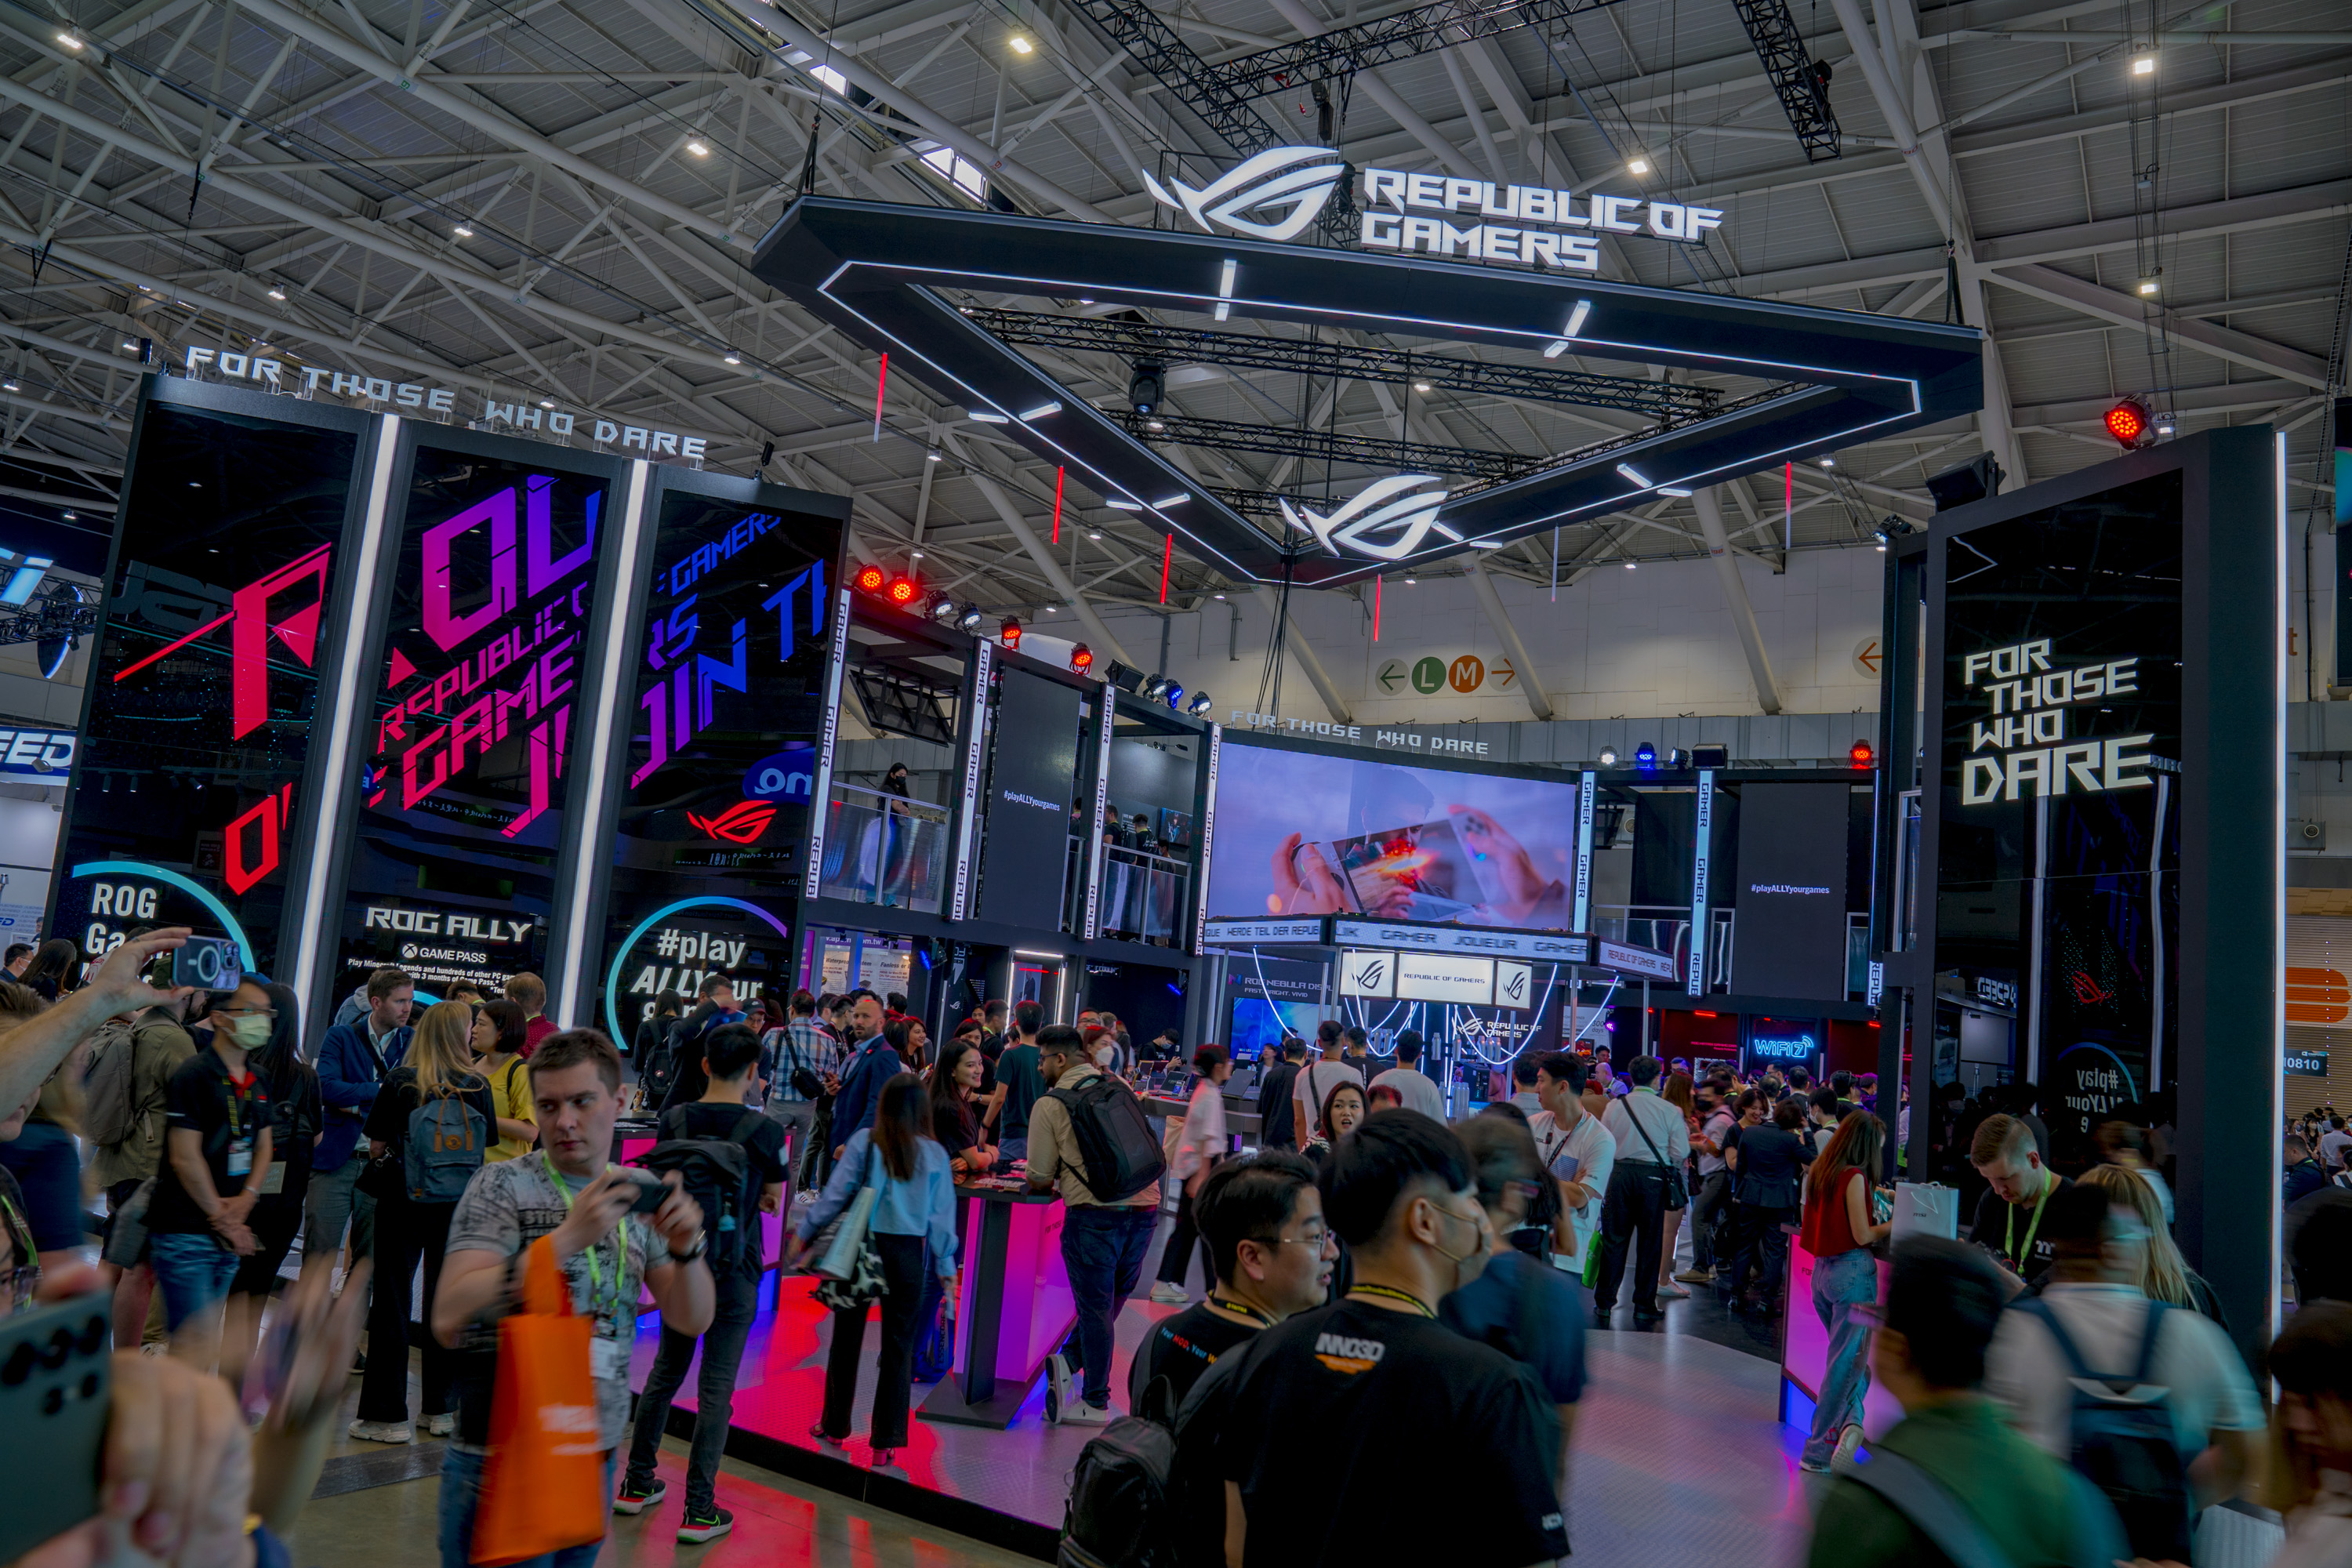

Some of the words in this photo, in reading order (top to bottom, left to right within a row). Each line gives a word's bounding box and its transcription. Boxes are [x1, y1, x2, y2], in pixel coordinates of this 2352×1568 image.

[1363, 168, 1642, 234] REPUBLIC
[1648, 201, 1724, 241] OF
[1362, 211, 1600, 270] GAMERS
[186, 346, 281, 383] FOR
[301, 366, 455, 412] THOSE
[485, 401, 575, 435] WHO
[594, 420, 707, 459] DARE
[833, 603, 847, 663] GAMER
[976, 649, 989, 705] GAMER
[1421, 663, 1435, 688] L
[1455, 662, 1477, 686] M
[1965, 638, 2052, 685] FOR
[1983, 658, 2139, 714] THOSE
[821, 706, 835, 768] GAMER
[1103, 693, 1112, 744] GAMER
[1232, 710, 1276, 728] FOR
[1286, 717, 1361, 739] THOSE
[1377, 730, 1421, 747] WHO
[1431, 736, 1488, 755] DARE
[1972, 709, 2063, 753] WHO
[967, 742, 978, 799] GAMER
[1962, 733, 2154, 805] DARE
[1004, 790, 1060, 811] #playALLYyourgames
[1096, 778, 1105, 829] GAMER
[1582, 782, 1592, 826] GAMER
[1700, 782, 1709, 828] GAMER
[1577, 855, 1588, 898] GAMER
[1696, 858, 1705, 903] GAMER
[1751, 884, 1830, 895] #playALLYyourgames
[91, 883, 157, 919] ROG
[365, 906, 441, 934] ROG
[446, 915, 532, 942] ALLY
[1227, 927, 1252, 936] WERDE
[1254, 927, 1270, 936] TEIL
[1273, 926, 1289, 936] DER
[1381, 930, 1437, 942] GAMER
[1455, 936, 1517, 949] JOUEUR
[347, 958, 363, 967] Play
[423, 965, 436, 974] and
[437, 967, 466, 976] hundreds
[419, 947, 456, 960] GAME
[456, 951, 487, 964] PASS
[657, 929, 746, 969] #play
[1608, 949, 1631, 963] REPUBLIC
[1632, 955, 1638, 964] OF
[1639, 956, 1656, 969] GAMERS
[630, 966, 763, 1003] ALLYur
[1266, 979, 1307, 989] NEBULA
[1161, 1327, 1174, 1340] Your
[1191, 1344, 1207, 1359] Your
[1315, 1333, 1386, 1363] INNO3D
